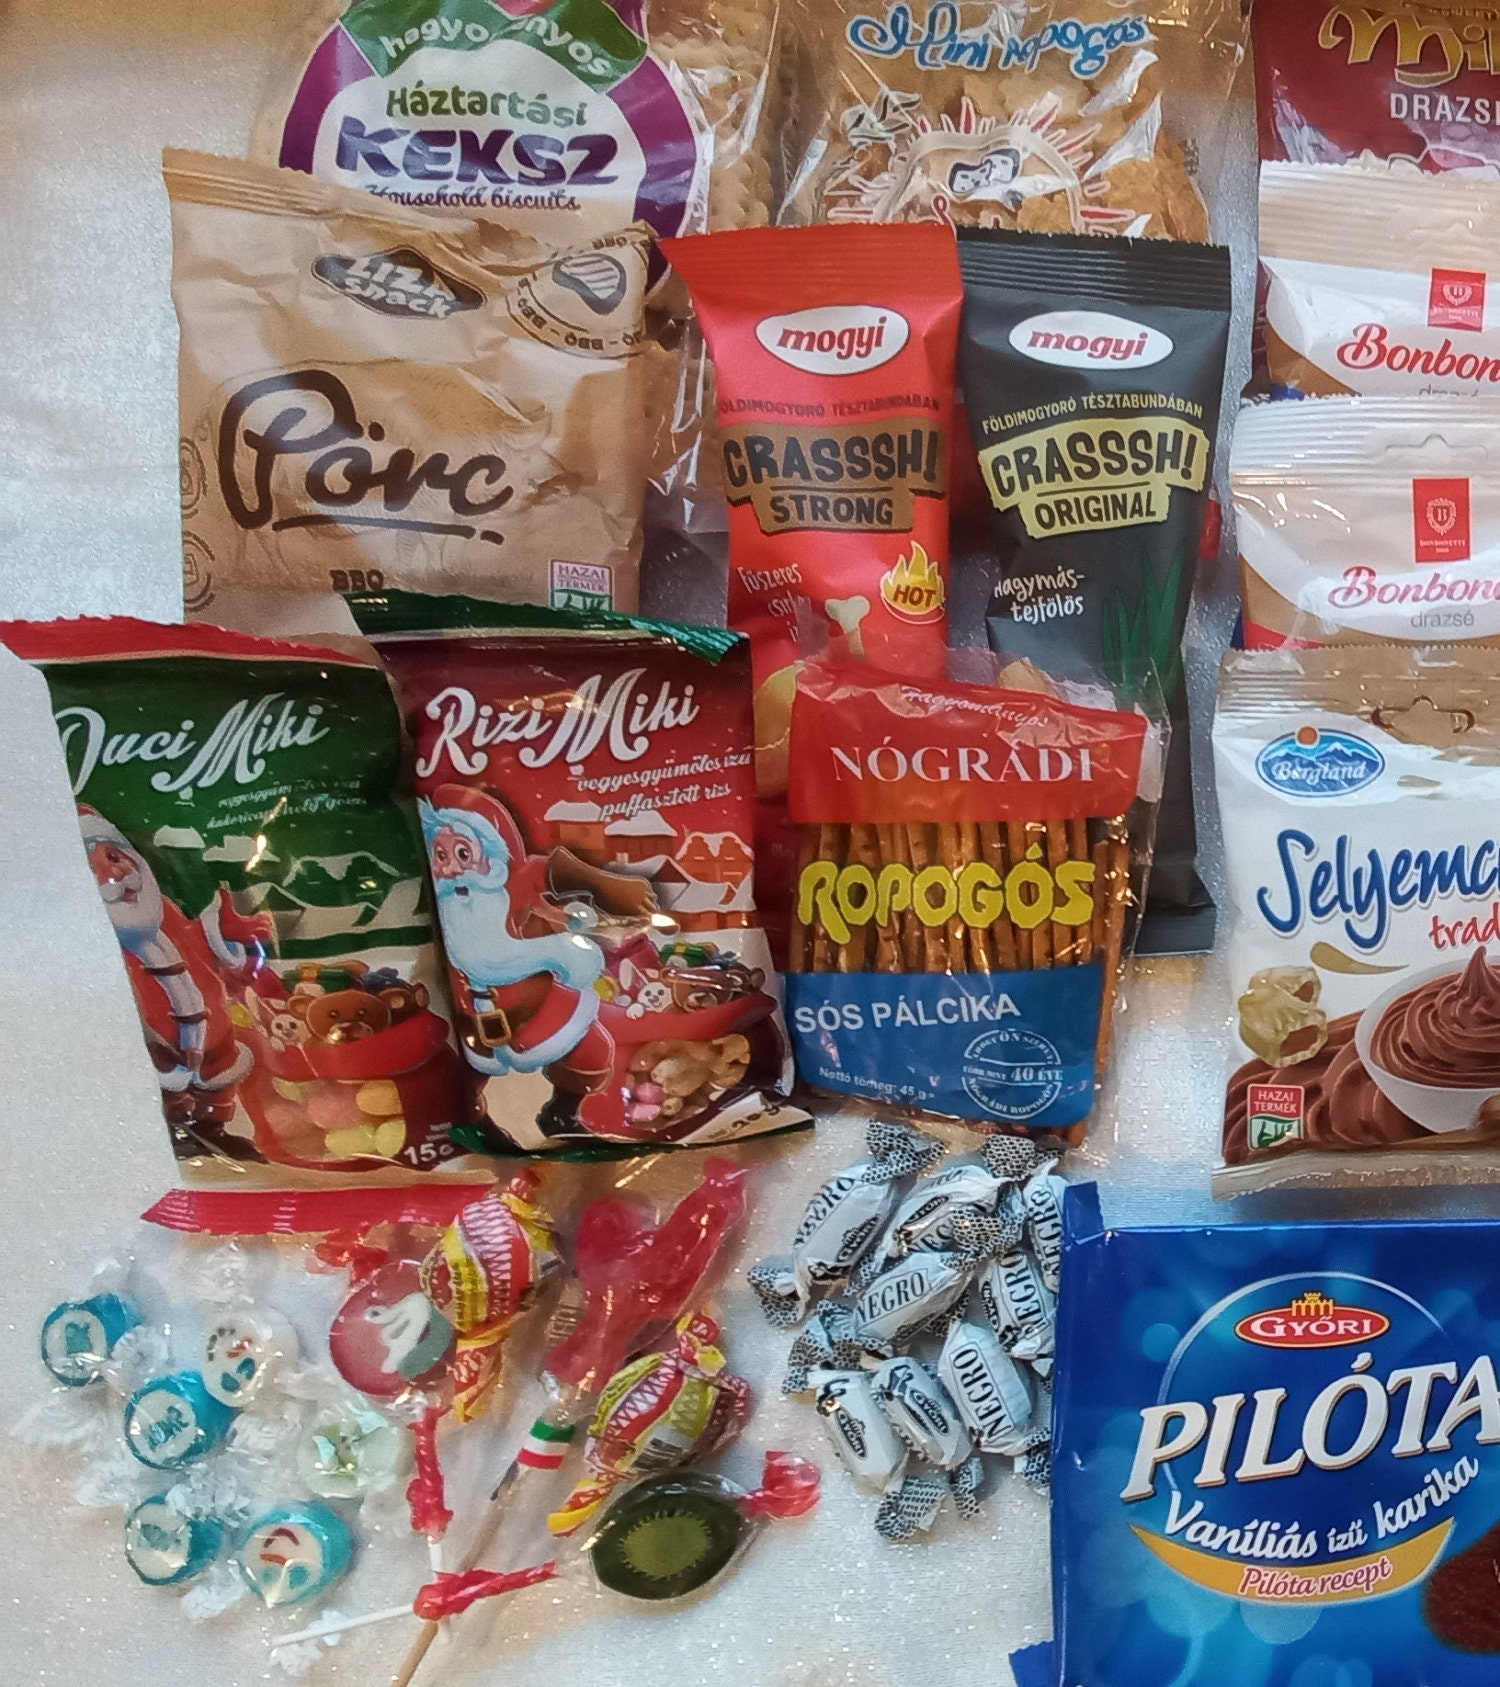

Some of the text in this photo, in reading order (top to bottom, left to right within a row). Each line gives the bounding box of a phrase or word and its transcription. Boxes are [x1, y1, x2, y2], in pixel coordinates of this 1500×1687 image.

[380, 15, 615, 77] hagyonyos
[386, 80, 587, 128] Háztartási
[335, 115, 619, 187] KEKSZ
[490, 186, 581, 211] biscuits
[777, 316, 888, 361] mogyi
[1026, 330, 1148, 361] mogyi
[719, 397, 825, 418] ÖLDIMOGYORÓ
[982, 391, 1203, 435] FÖLDIMOGYORÓ TÉSZTABUNDÁBAN
[218, 368, 514, 531] Pörc
[723, 428, 940, 488] CRASSSH!
[991, 429, 1198, 498] CRASSSH!
[771, 495, 893, 526] STRONG
[1035, 490, 1157, 530] ORIGINAL
[331, 569, 384, 591] BBQ
[558, 564, 606, 579] HAZAI
[893, 584, 937, 609] HOT
[1010, 594, 1085, 625] tejfölös
[1410, 610, 1475, 629] drazsé
[150, 691, 332, 795] Miki
[416, 667, 702, 779] Rizi Miki
[830, 735, 1097, 783] NÓGRÁDI
[1271, 757, 1368, 783] Bergland
[704, 782, 731, 800] rizs
[797, 842, 1097, 945] ROPOGÓS
[794, 993, 1022, 1034] SÓS PÁLCIKA
[900, 1085, 915, 1096] 45
[1010, 1067, 1034, 1081] 40
[1038, 1066, 1063, 1081] ÉVE
[1254, 1100, 1298, 1115] TERMÉK
[1258, 1089, 1294, 1102] HAZAI
[856, 1271, 927, 1325] NEGRO
[1250, 1312, 1373, 1339] GYŐRI
[952, 1346, 1014, 1442] NEGRO
[1161, 1453, 1480, 1561] Vaníliás ízű karika
[1239, 1554, 1394, 1599] Pilóta recept
